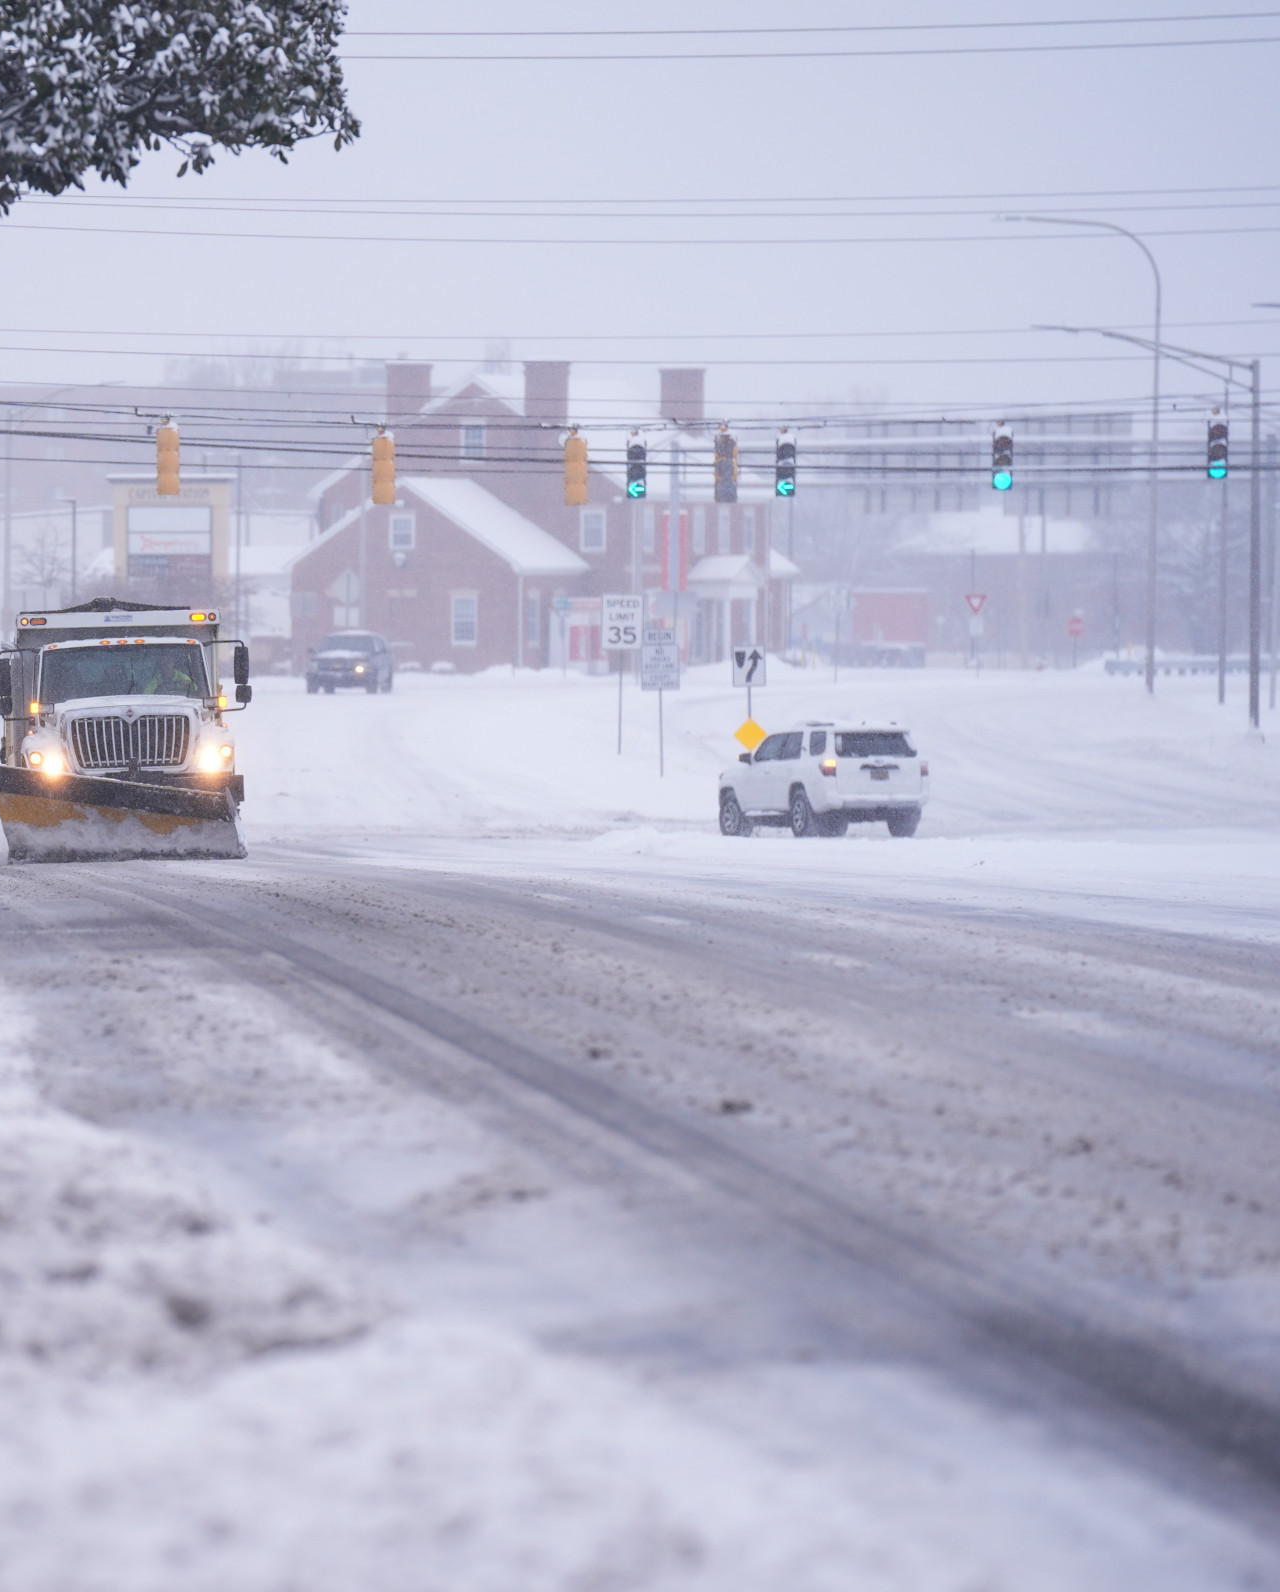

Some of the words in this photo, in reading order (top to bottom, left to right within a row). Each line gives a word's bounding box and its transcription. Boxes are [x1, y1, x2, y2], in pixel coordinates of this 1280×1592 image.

[606, 599, 640, 608] SPEED
[609, 612, 635, 621] LIMIT
[608, 626, 637, 644] 35
[647, 632, 672, 641] BEGIN
